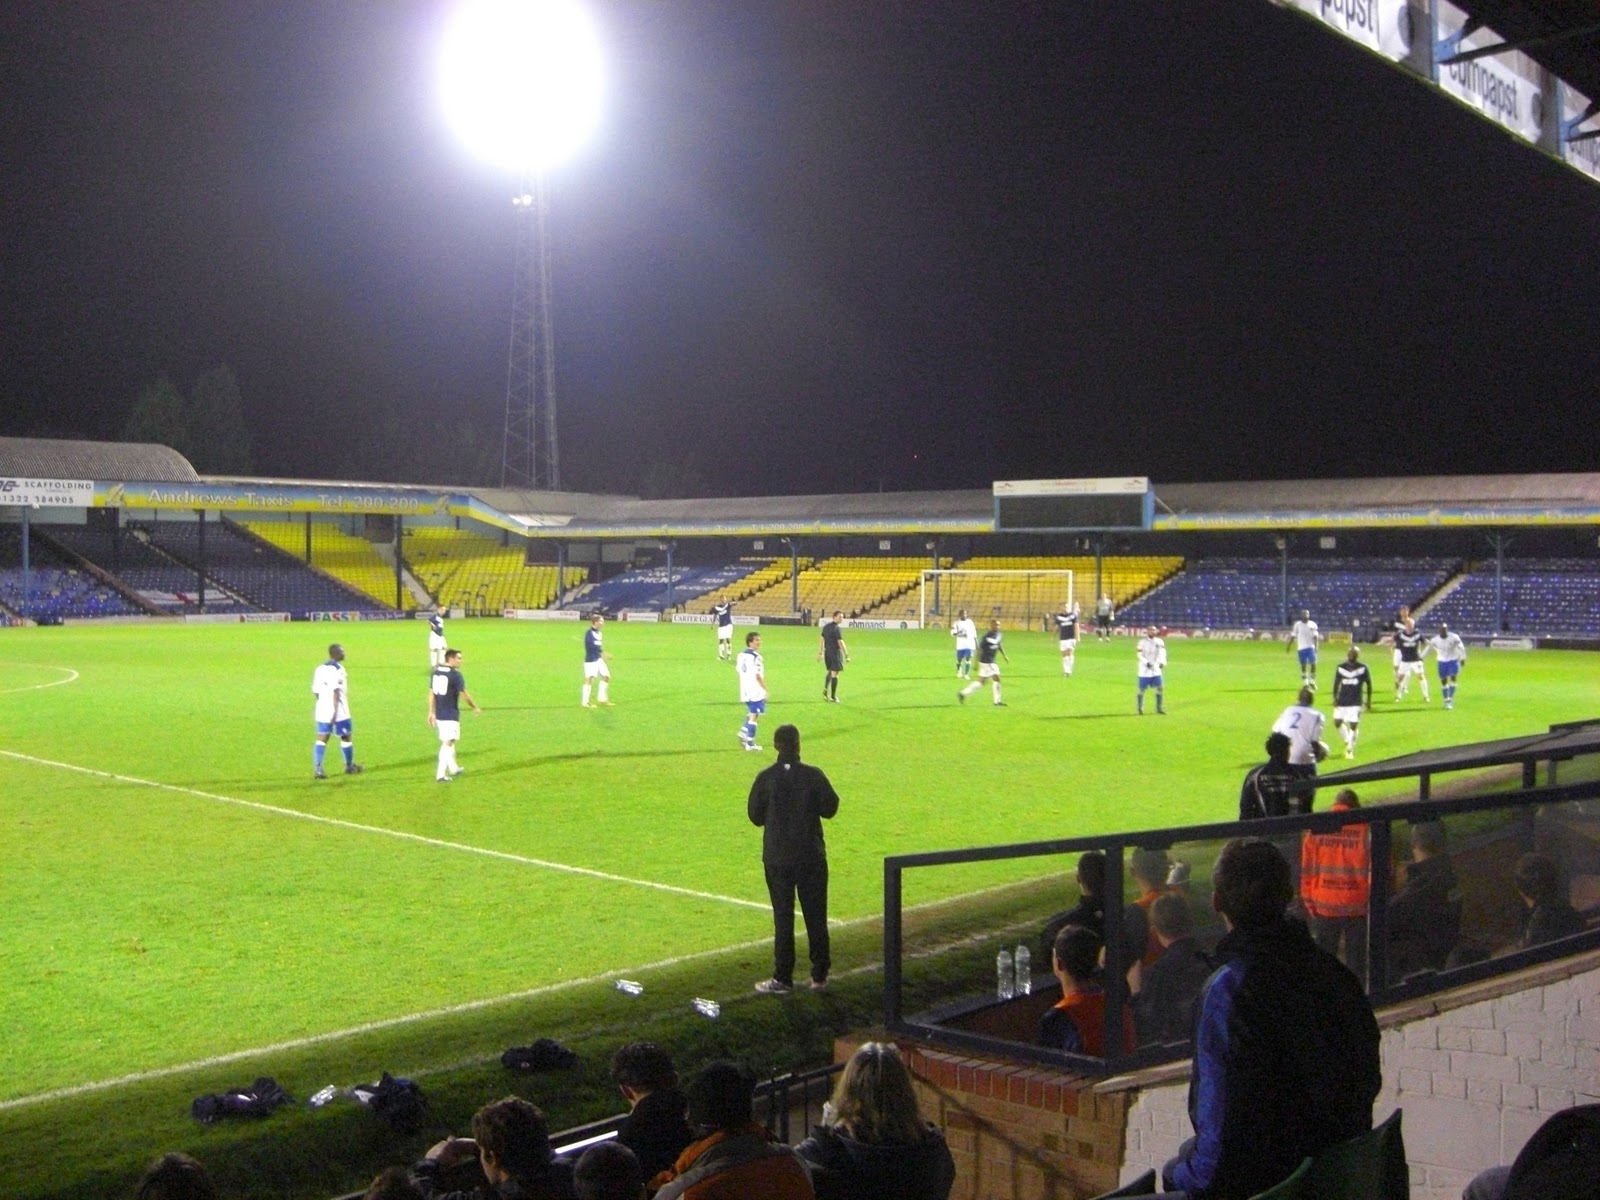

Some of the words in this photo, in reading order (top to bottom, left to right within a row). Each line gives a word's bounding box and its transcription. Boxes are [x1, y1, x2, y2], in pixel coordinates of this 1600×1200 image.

[24, 481, 92, 490] SCAFFOLDING
[0, 494, 29, 503] 1322
[147, 489, 237, 505] Andrews
[244, 491, 293, 506] Taxis
[1290, 711, 1302, 729] 2
